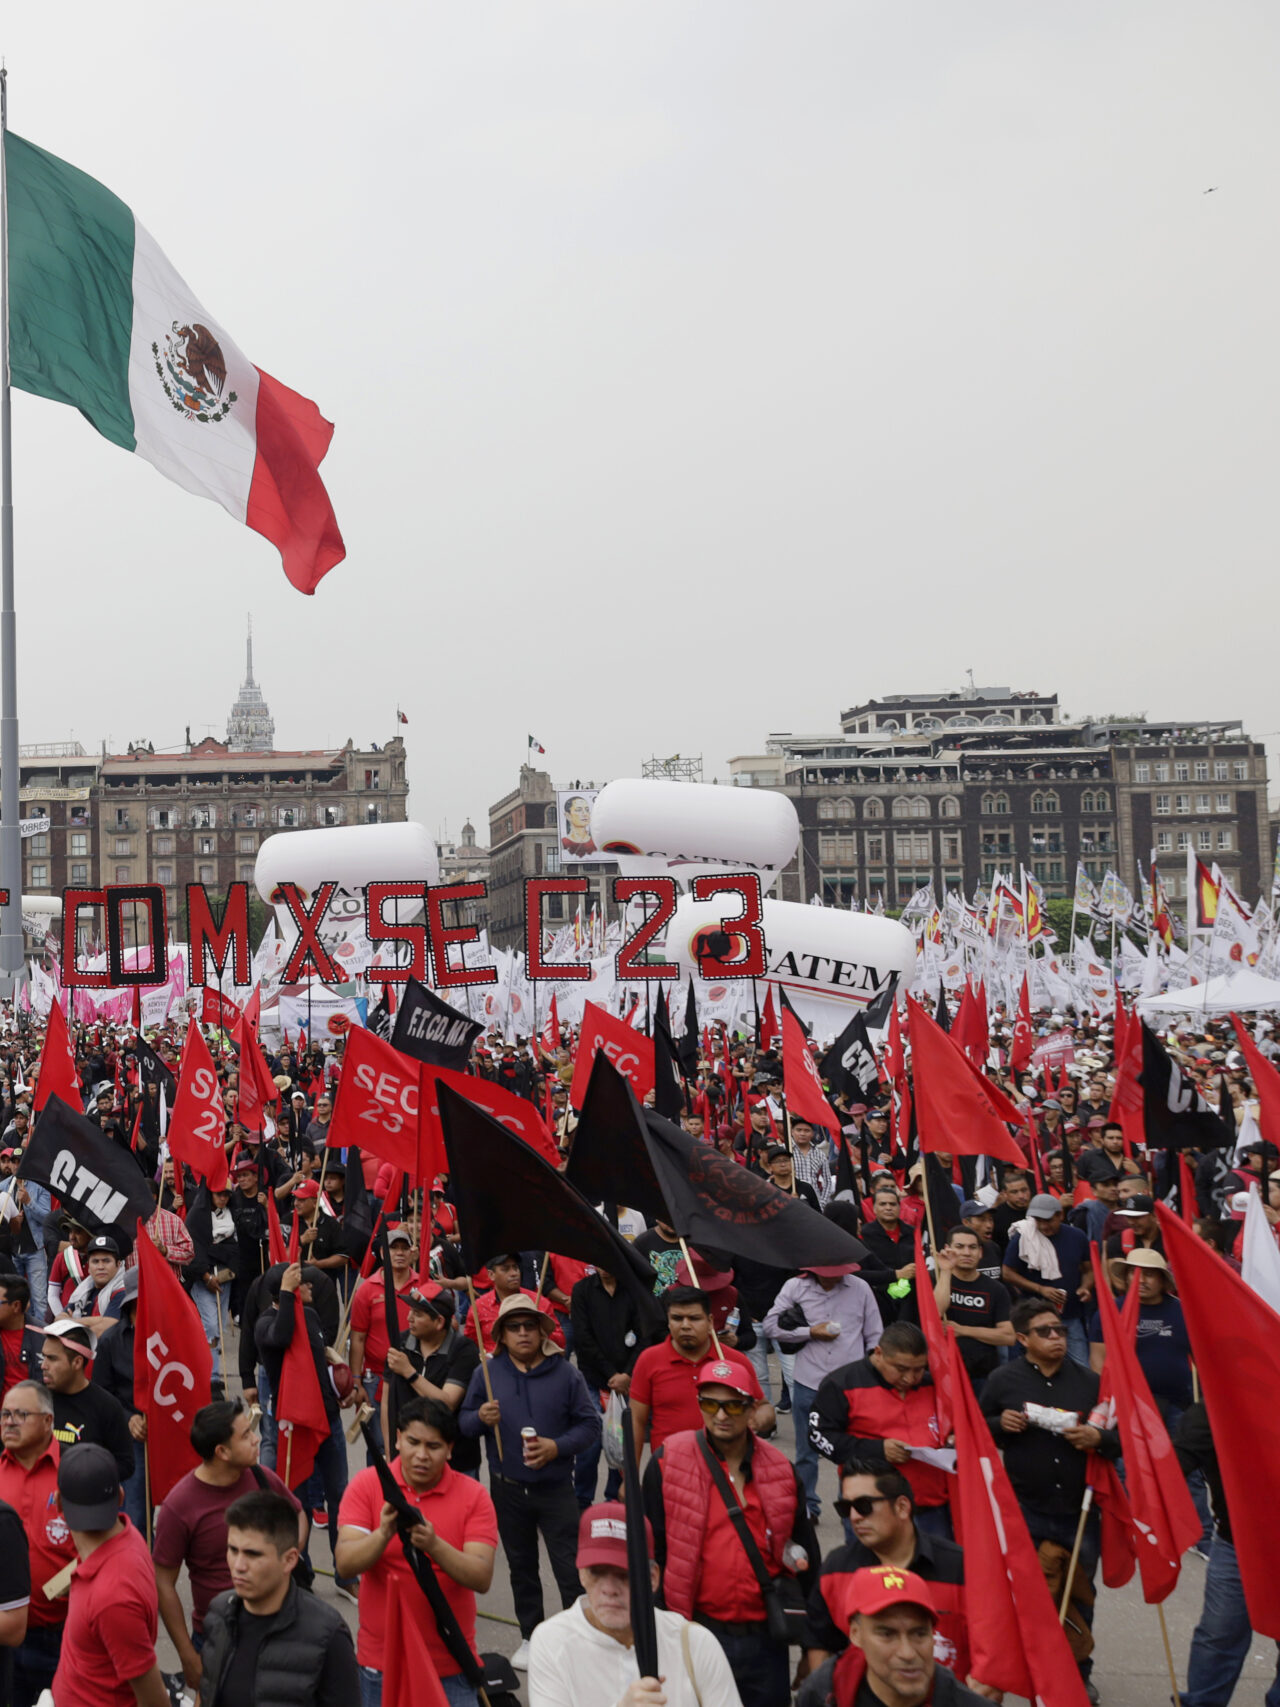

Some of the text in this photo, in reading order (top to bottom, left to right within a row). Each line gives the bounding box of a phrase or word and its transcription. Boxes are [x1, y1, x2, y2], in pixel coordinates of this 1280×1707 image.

[20, 820, 50, 834] OBRES
[764, 947, 901, 993] ATEM
[358, 1099, 405, 1133] 23
[49, 1149, 129, 1225] CTM
[53, 1429, 76, 1444] UMA
